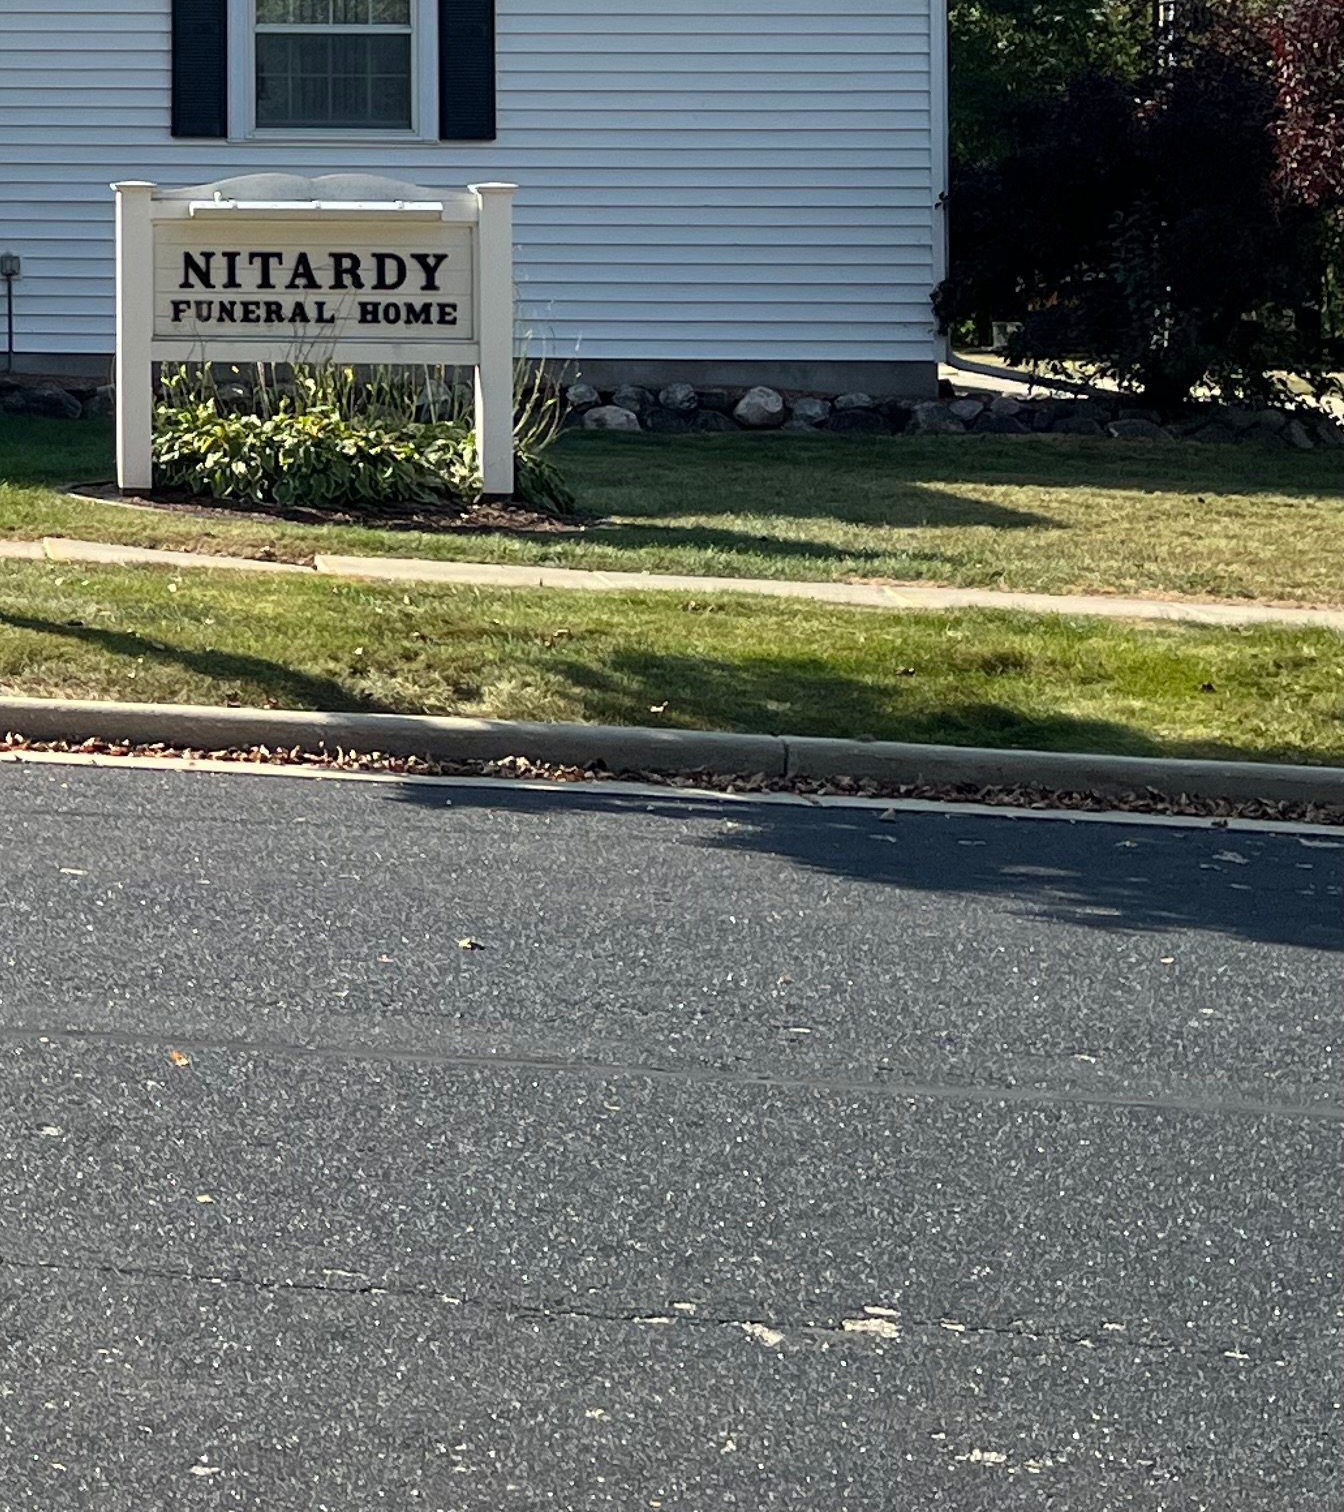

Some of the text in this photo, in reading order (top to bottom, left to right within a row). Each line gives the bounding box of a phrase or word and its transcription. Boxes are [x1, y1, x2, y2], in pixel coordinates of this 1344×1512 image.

[178, 251, 449, 291] NITARDY
[170, 299, 458, 325] FUNERAL HOME
